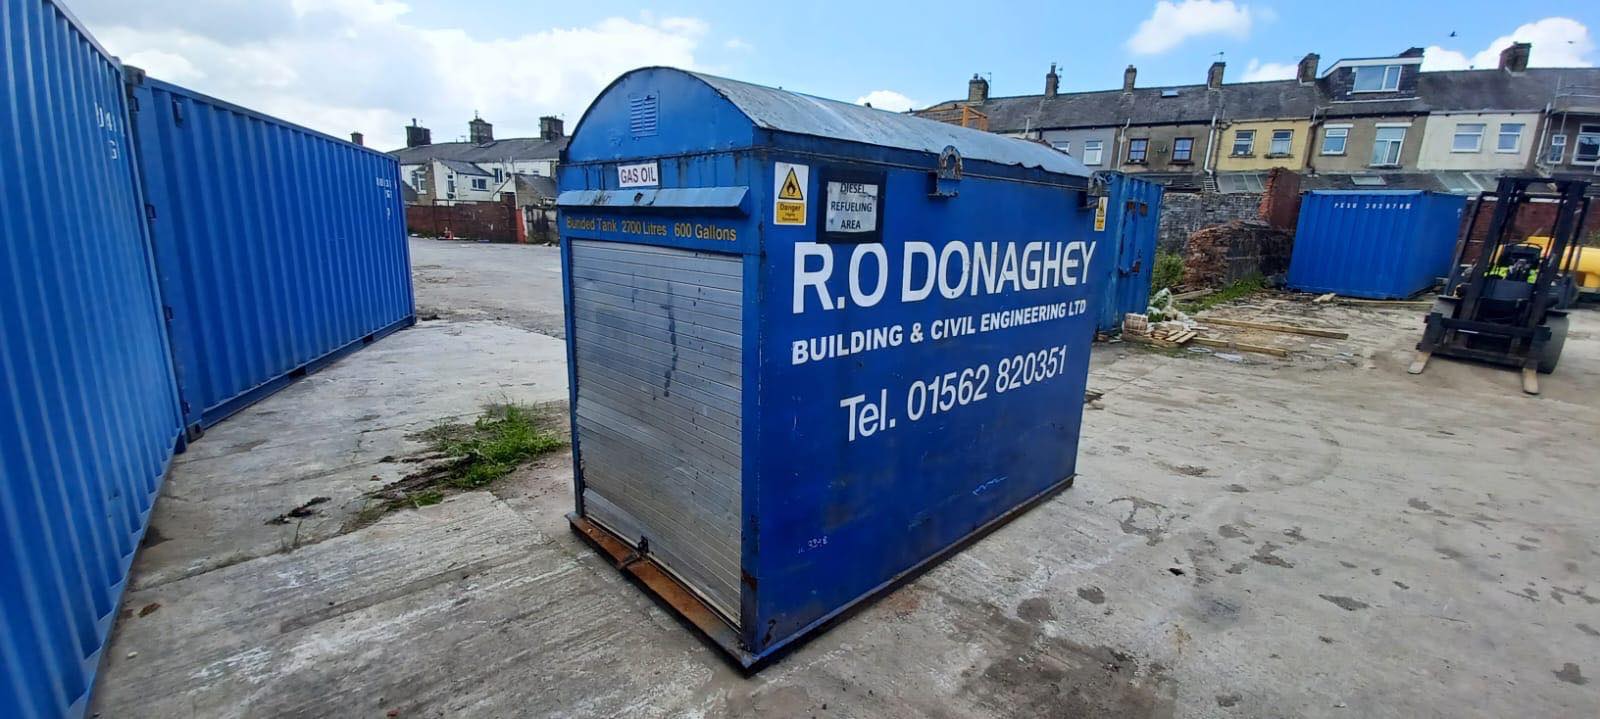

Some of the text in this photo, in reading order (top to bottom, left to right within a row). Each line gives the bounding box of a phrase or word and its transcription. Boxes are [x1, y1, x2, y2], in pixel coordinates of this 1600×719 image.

[620, 166, 657, 184] GAS OIL
[840, 182, 865, 194] DIESEL
[779, 203, 801, 212] Danger
[830, 201, 873, 212] REFUELING
[566, 215, 737, 242] Bunded Tank 2700 Litres 600 Gallons
[840, 219, 862, 230] AREA
[901, 240, 1097, 303] DONAGHEY
[791, 299, 1087, 366] BUILDING & CIVIL ENGINEERING LTD
[839, 345, 1068, 443] Tel. 01562 820351
